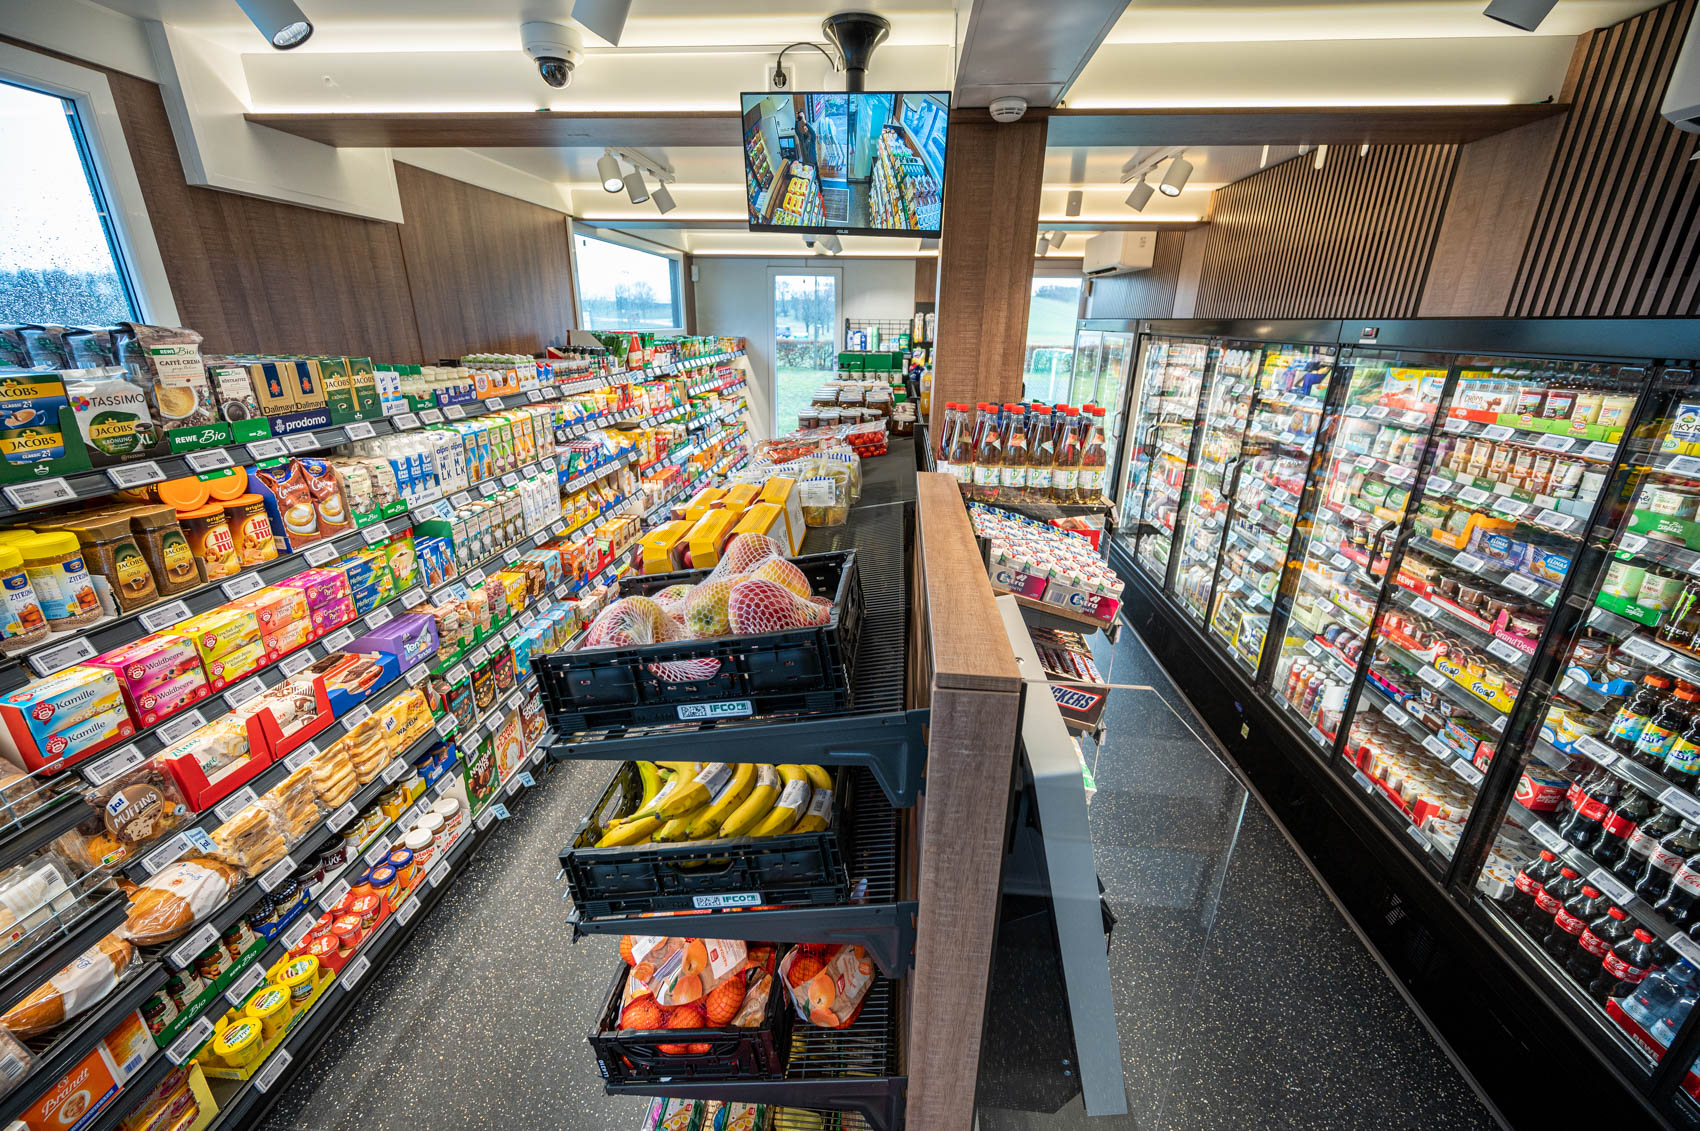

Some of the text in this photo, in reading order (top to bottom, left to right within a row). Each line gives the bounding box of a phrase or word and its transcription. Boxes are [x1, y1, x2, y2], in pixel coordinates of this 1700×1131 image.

[176, 345, 195, 356] Bio
[325, 379, 349, 389] JACOBS
[353, 376, 375, 386] JACOBS
[89, 393, 146, 408] TASSIMO
[296, 401, 324, 411] Dallmayr
[264, 403, 295, 415] Dallmayr
[286, 414, 327, 432] prodomo
[94, 425, 133, 437] JACOBS
[176, 429, 226, 445] REWE Bio
[9, 436, 57, 451] JACOBS
[102, 436, 133, 445] KRÖNUNG
[136, 433, 153, 445] XL
[164, 545, 188, 556] JACOBS
[118, 558, 144, 570] JACOBS
[1396, 573, 1415, 588] REWE
[145, 650, 184, 671] Waldbeere
[156, 679, 195, 700] Waldbeere
[55, 688, 96, 710] Kamille
[710, 702, 735, 714] IFCO
[68, 720, 106, 743] Kamille
[109, 797, 125, 813] ja!
[113, 791, 157, 829] MUFFINS
[413, 846, 435, 860] utella
[722, 895, 747, 904] IFCO
[241, 950, 257, 968] Bio
[174, 998, 207, 1031] REWE Bio
[1632, 1034, 1660, 1060] REWE
[41, 1067, 90, 1116] Brandt
